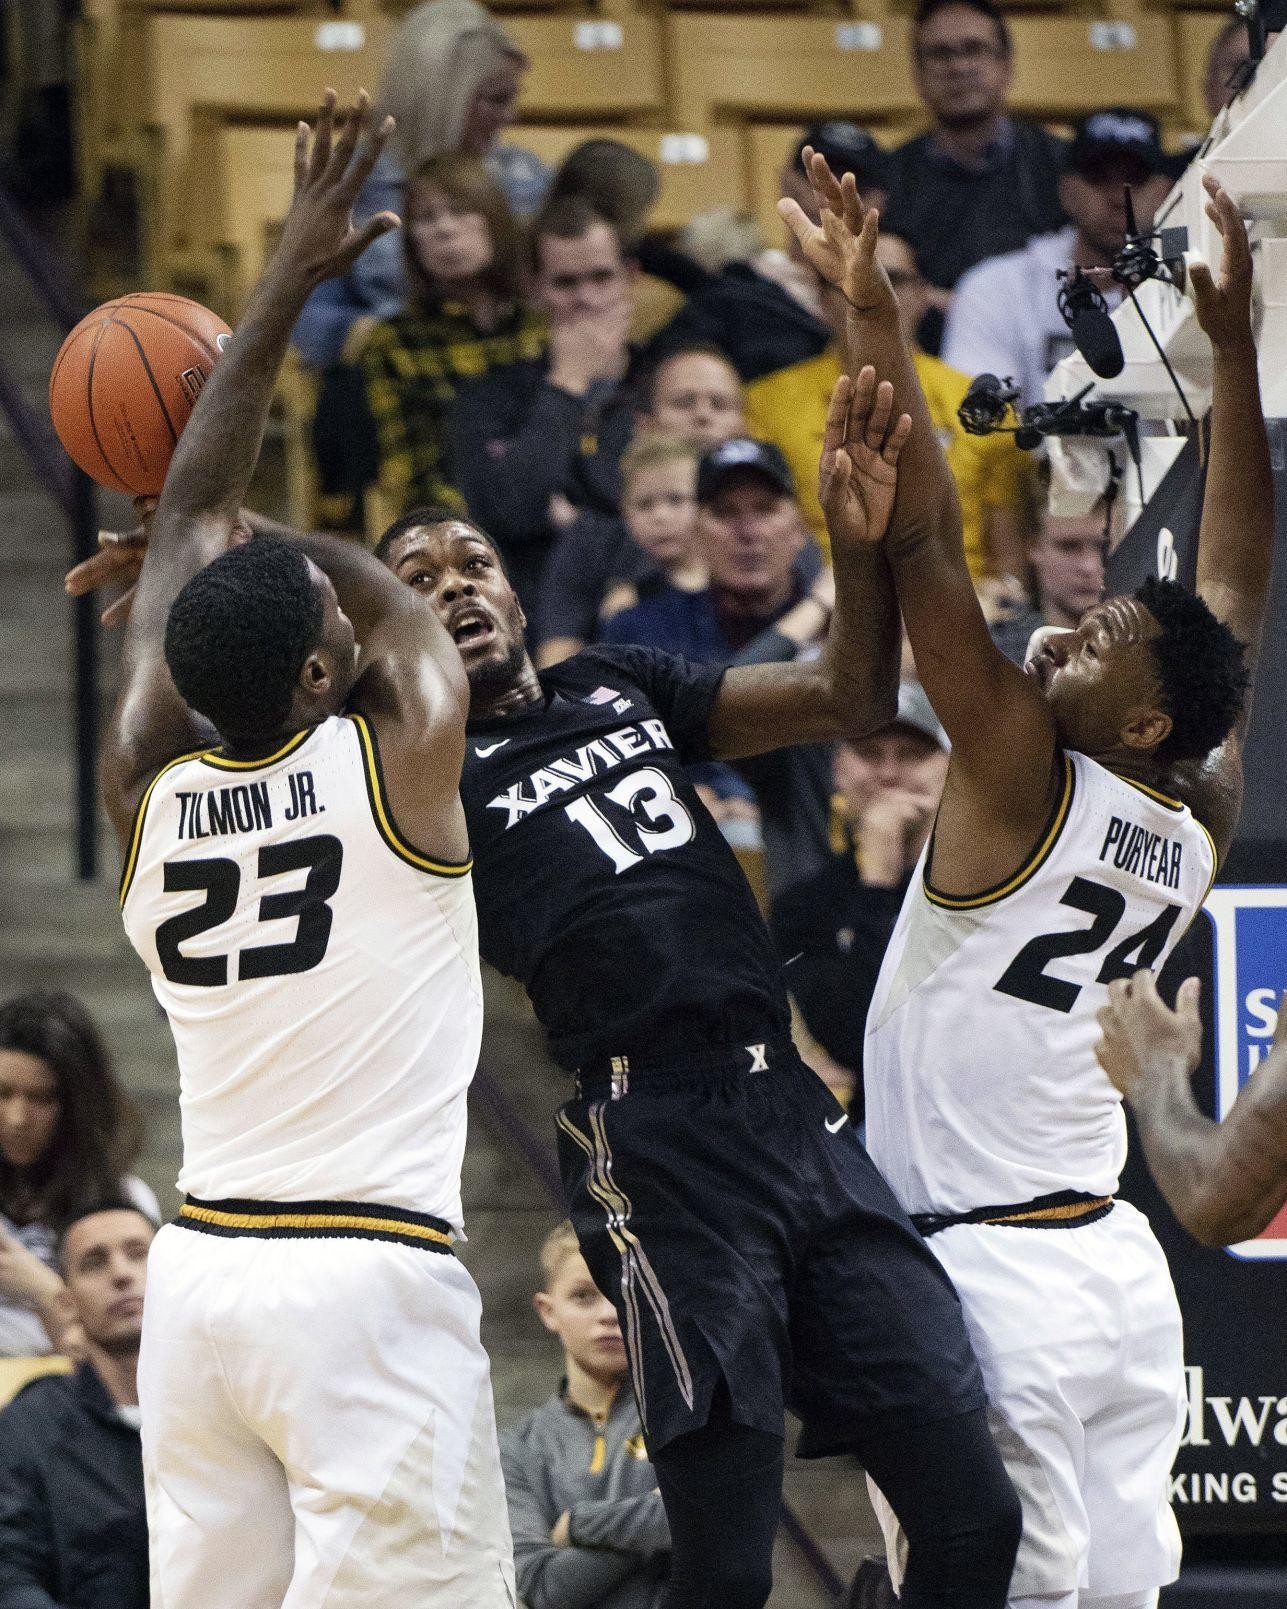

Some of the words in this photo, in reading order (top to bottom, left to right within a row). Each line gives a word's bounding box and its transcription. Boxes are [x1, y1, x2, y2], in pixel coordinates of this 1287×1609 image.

[175, 781, 273, 840] TILMON
[284, 770, 326, 821] JR.
[486, 719, 674, 830] XAVIER
[564, 766, 697, 875] 13
[1099, 815, 1182, 889] PURYEAR
[155, 833, 344, 988] 23
[992, 875, 1183, 1014] 24
[1245, 987, 1287, 1038] S
